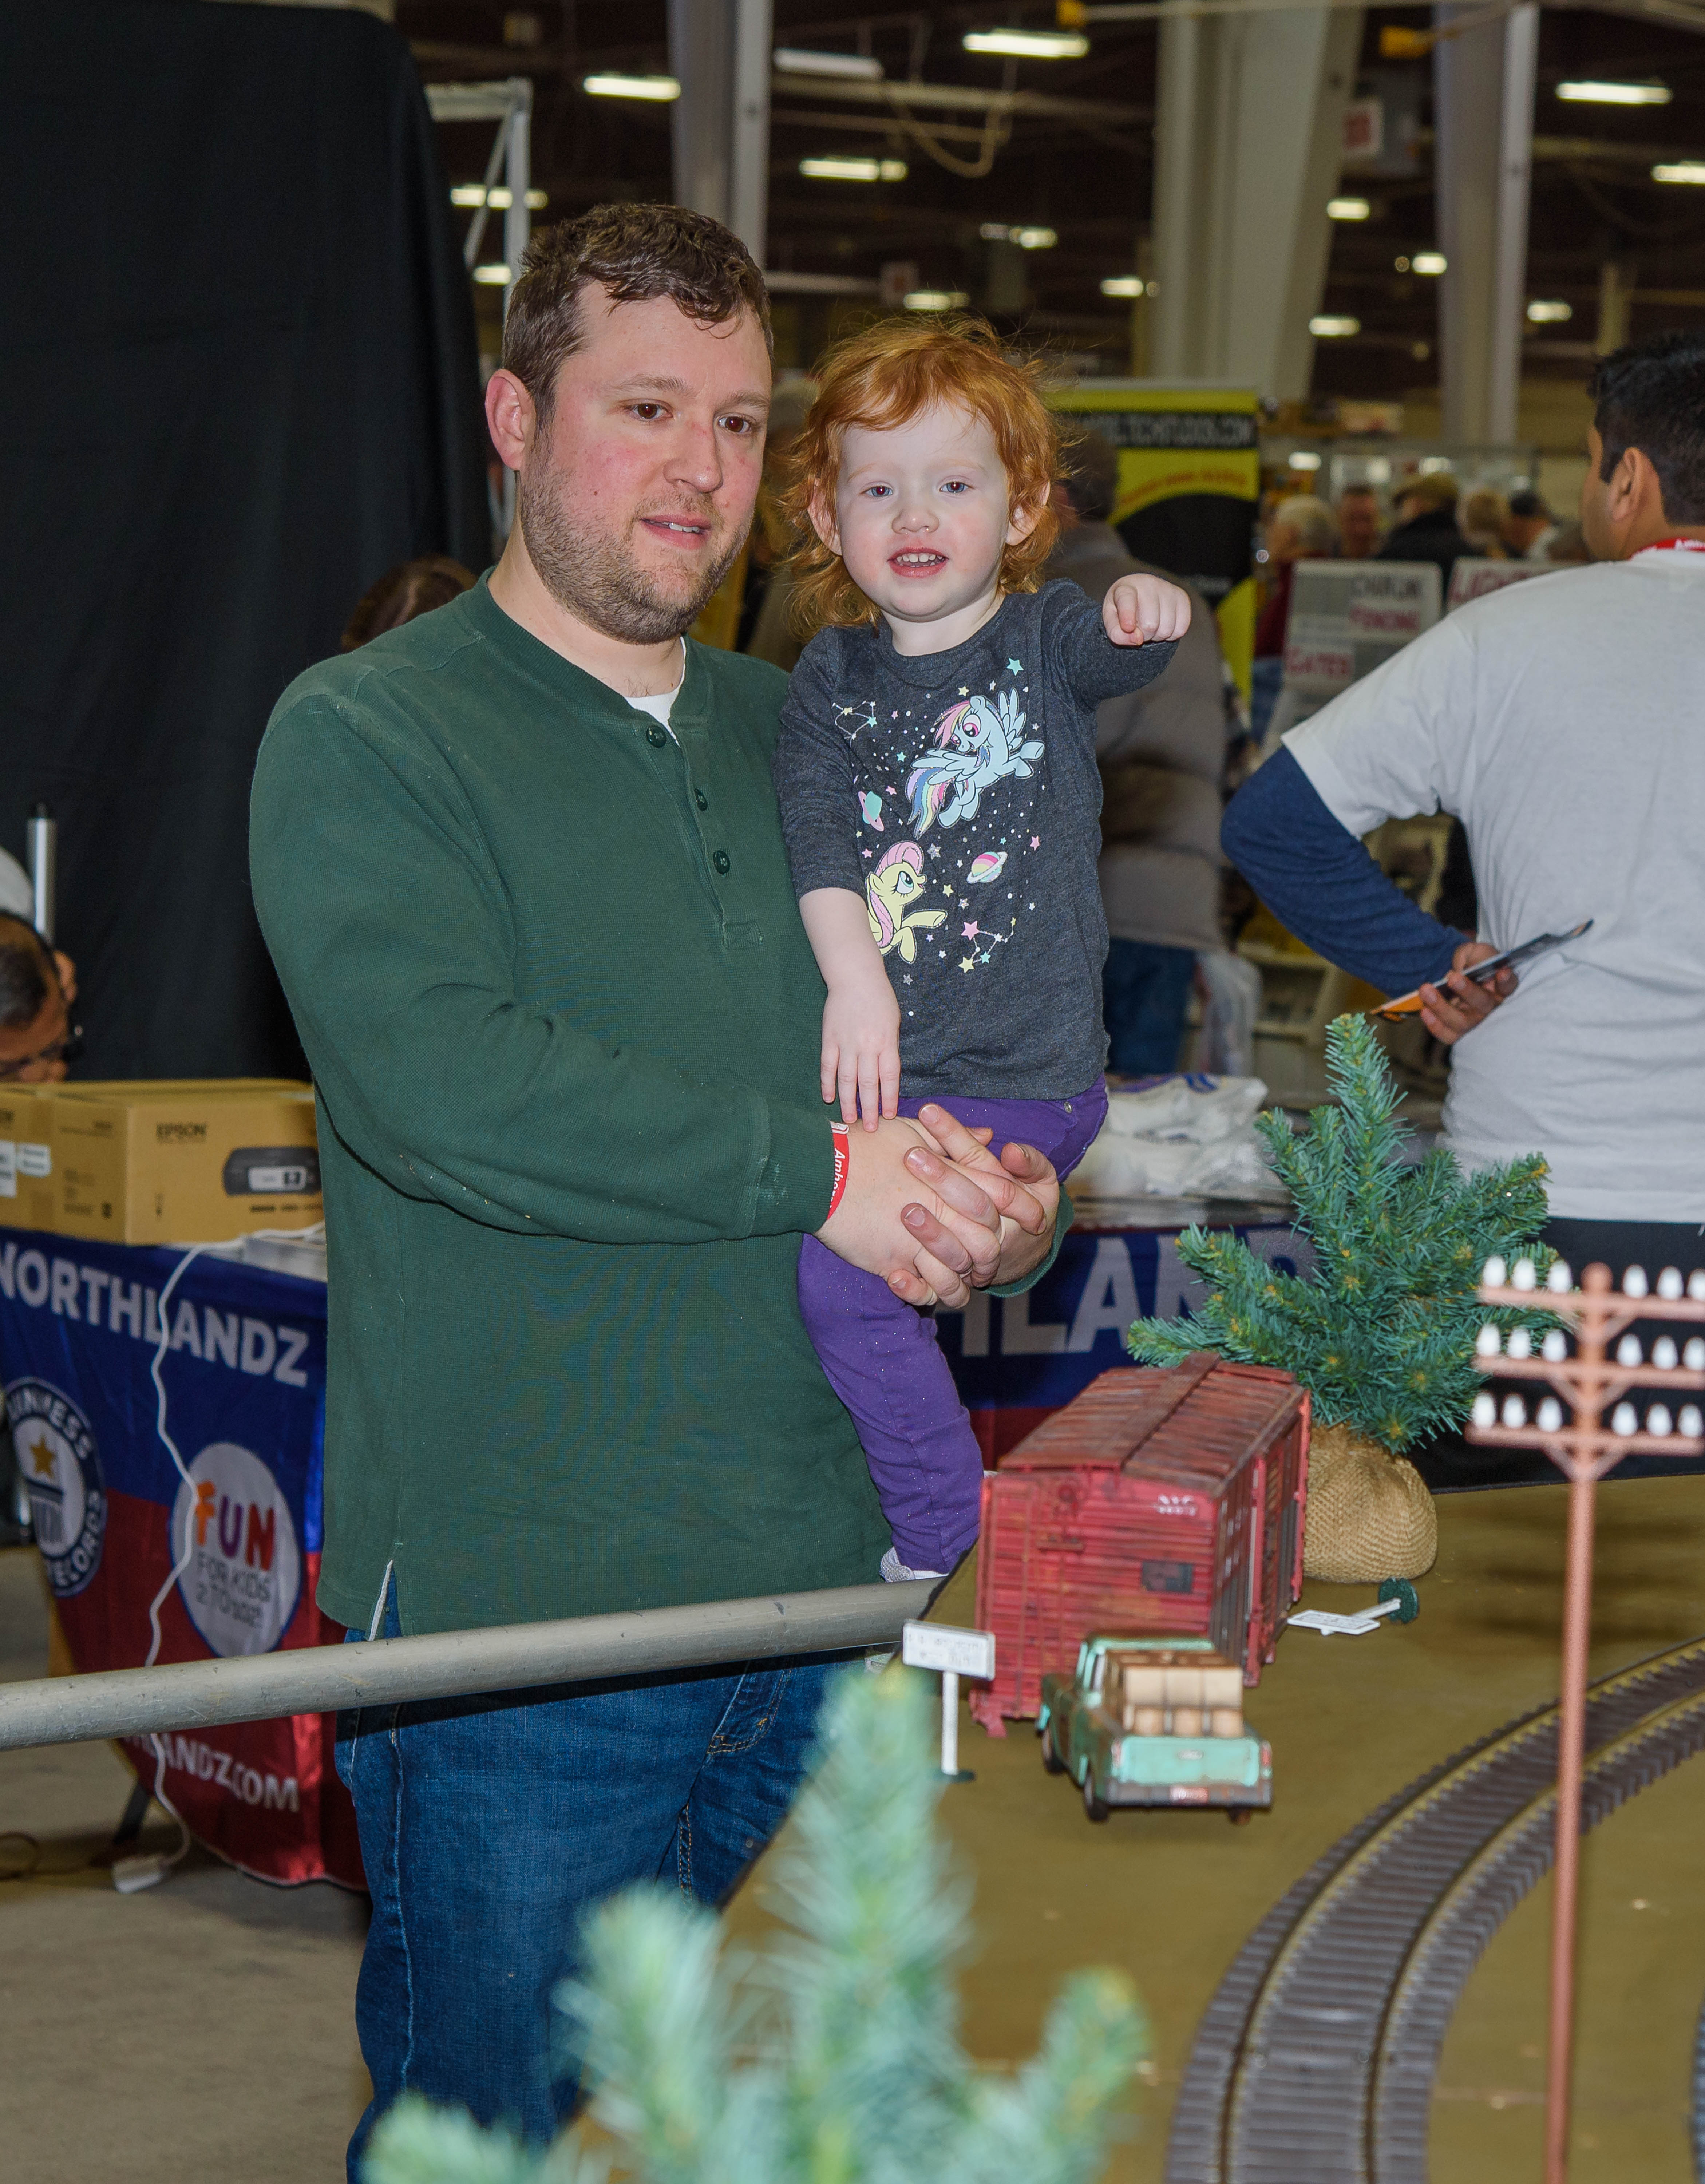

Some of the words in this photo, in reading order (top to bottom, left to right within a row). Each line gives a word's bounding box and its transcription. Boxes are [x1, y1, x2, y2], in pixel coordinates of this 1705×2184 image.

[157, 1122, 207, 1138] EPSON
[830, 1147, 846, 1208] Amhe
[195, 1480, 276, 1572] FUN
